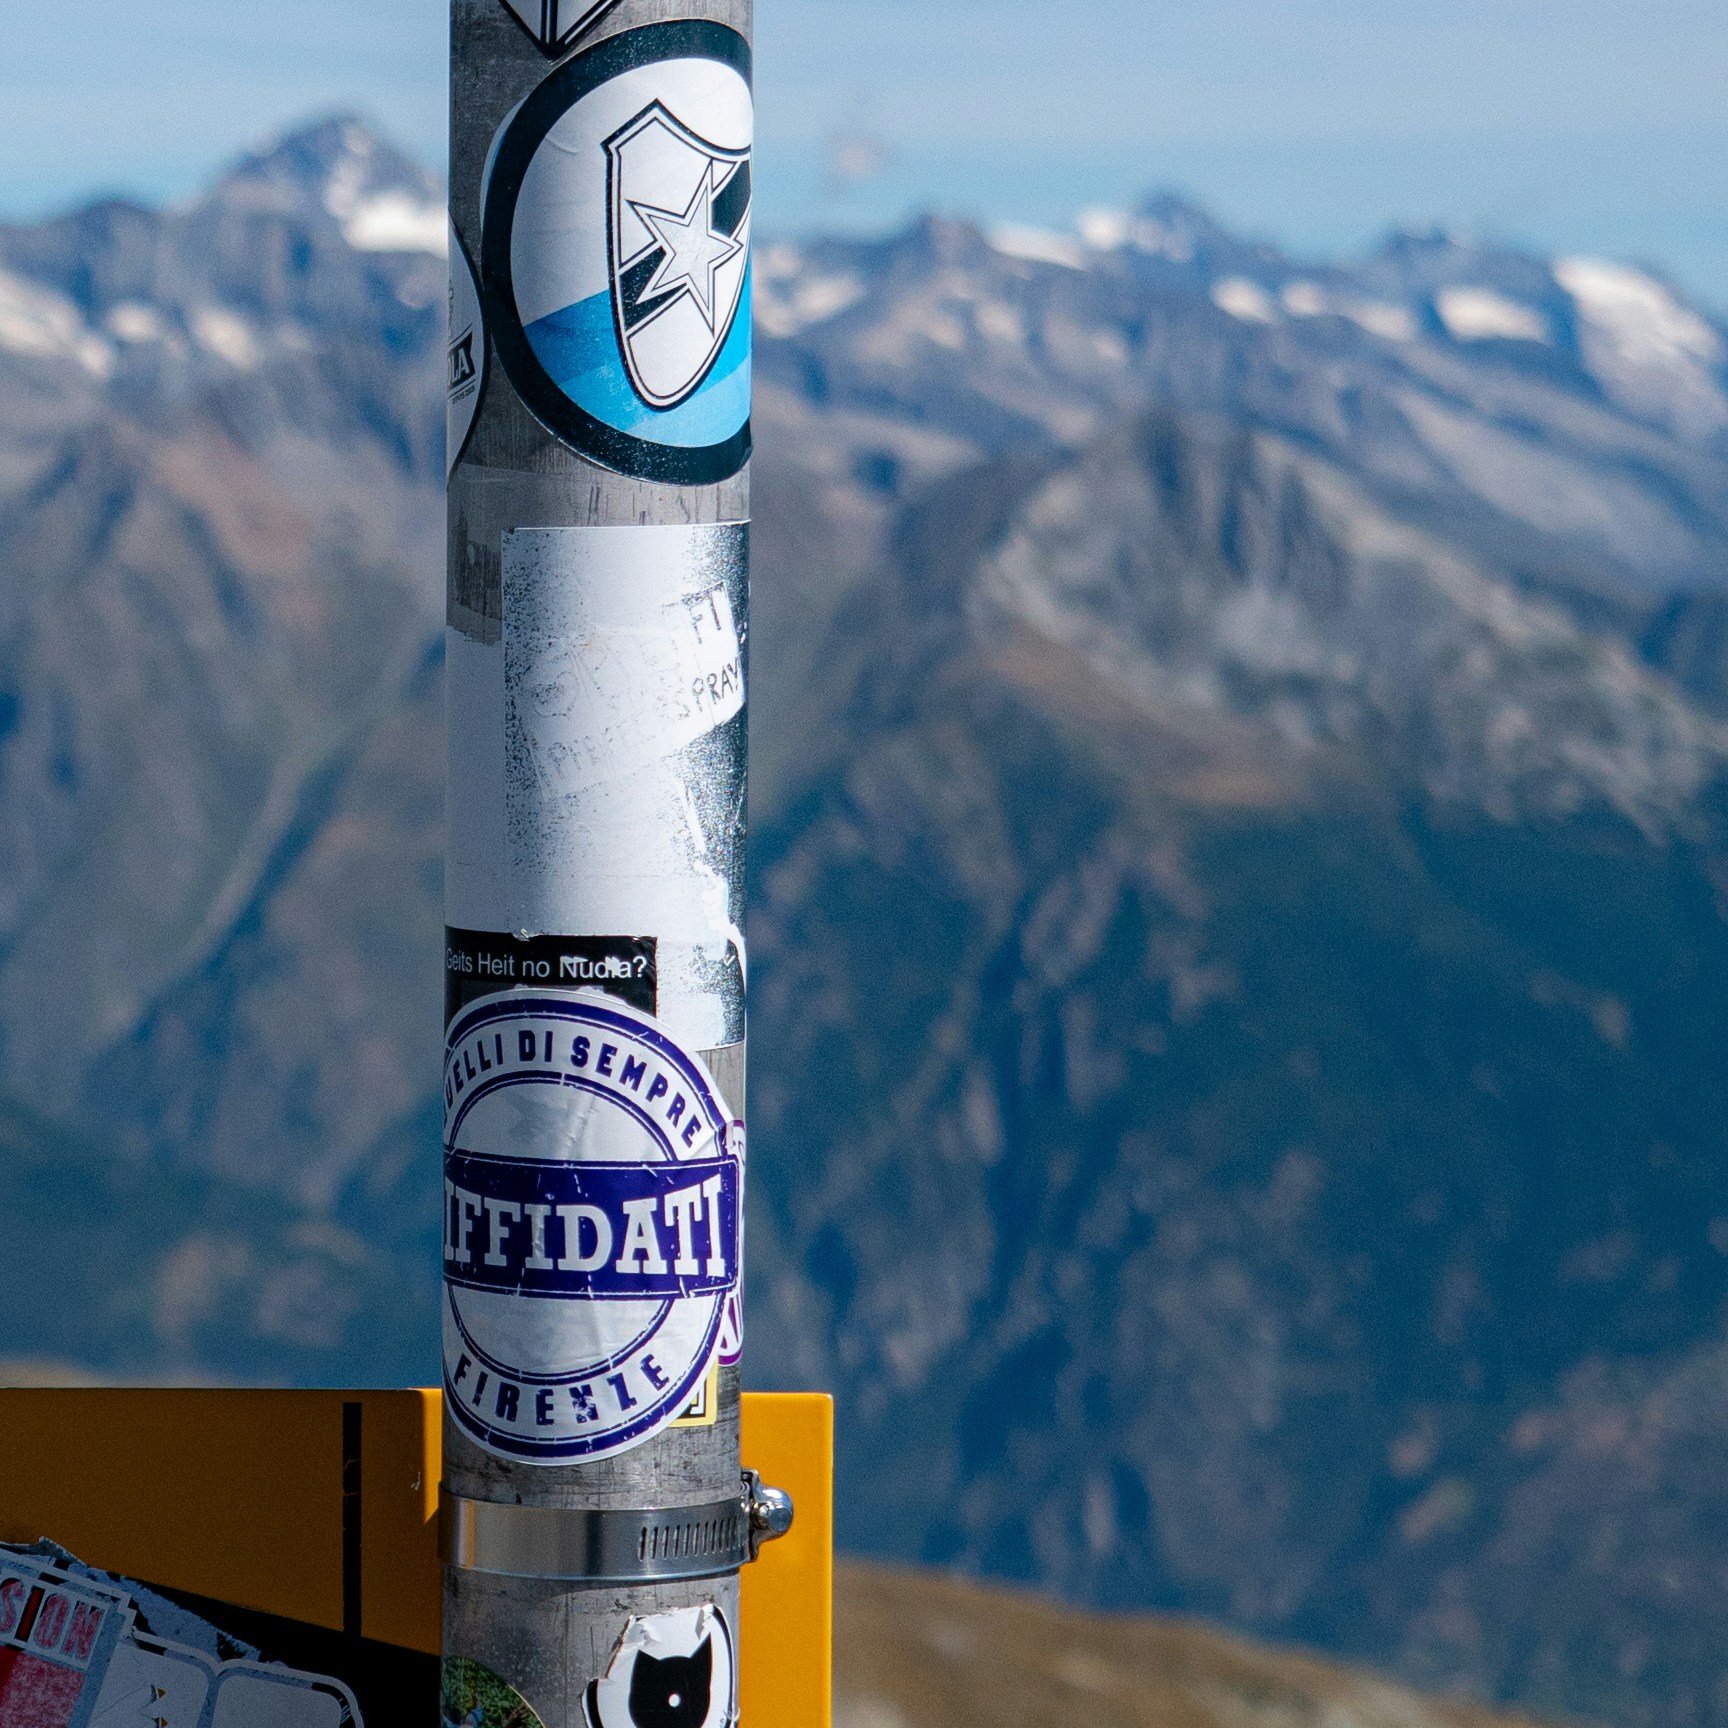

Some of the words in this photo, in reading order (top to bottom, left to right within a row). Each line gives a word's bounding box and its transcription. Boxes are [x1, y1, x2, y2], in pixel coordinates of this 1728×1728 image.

[477, 952, 516, 977] Heit
[521, 961, 552, 979] no
[518, 1029, 554, 1063] DI
[570, 1035, 702, 1149] SEMPRE
[453, 1353, 670, 1426] FIRENZE
